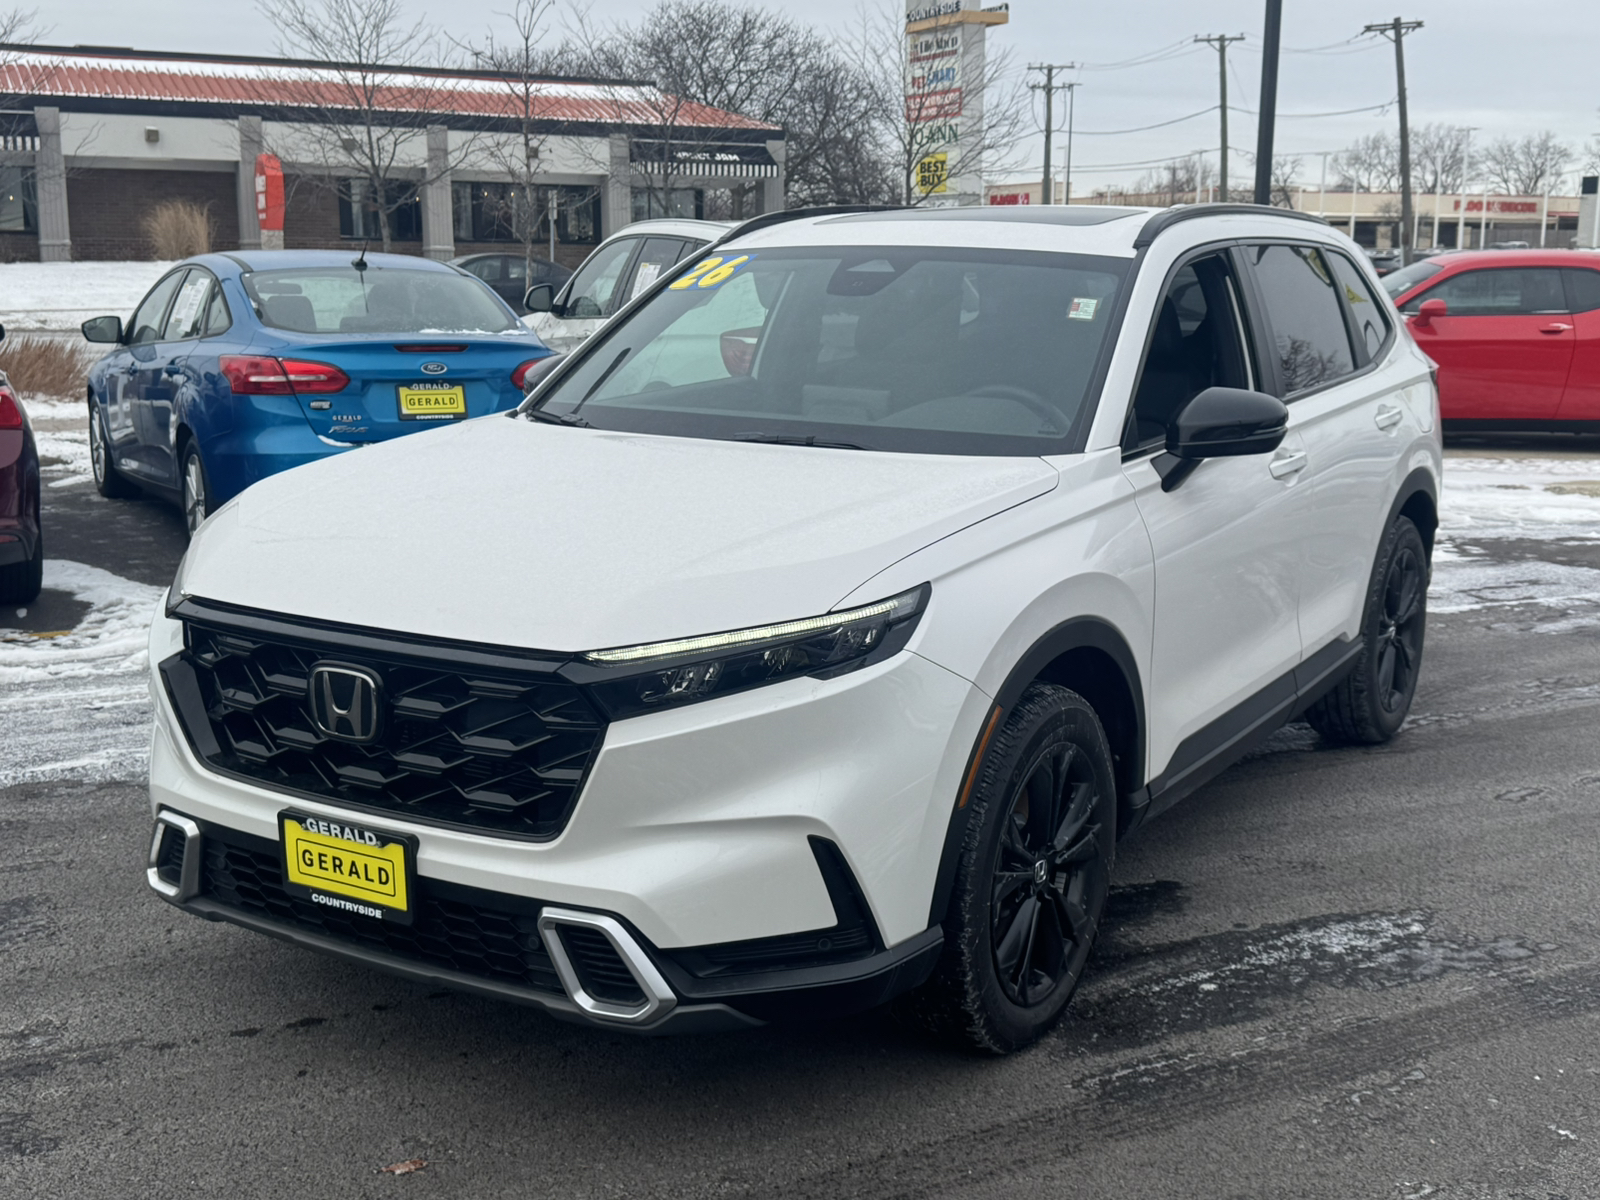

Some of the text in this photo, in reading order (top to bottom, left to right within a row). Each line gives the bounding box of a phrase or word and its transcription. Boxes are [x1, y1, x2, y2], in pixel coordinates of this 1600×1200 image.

[912, 123, 959, 146] OANN
[920, 160, 946, 174] BEST
[920, 173, 943, 187] BUY
[669, 255, 748, 290] 26
[413, 383, 450, 391] GERALD
[408, 397, 456, 407] GERALD
[306, 818, 377, 847] GERALD
[302, 849, 391, 886] GERALD
[311, 893, 383, 919] COUNTRYSIDE
